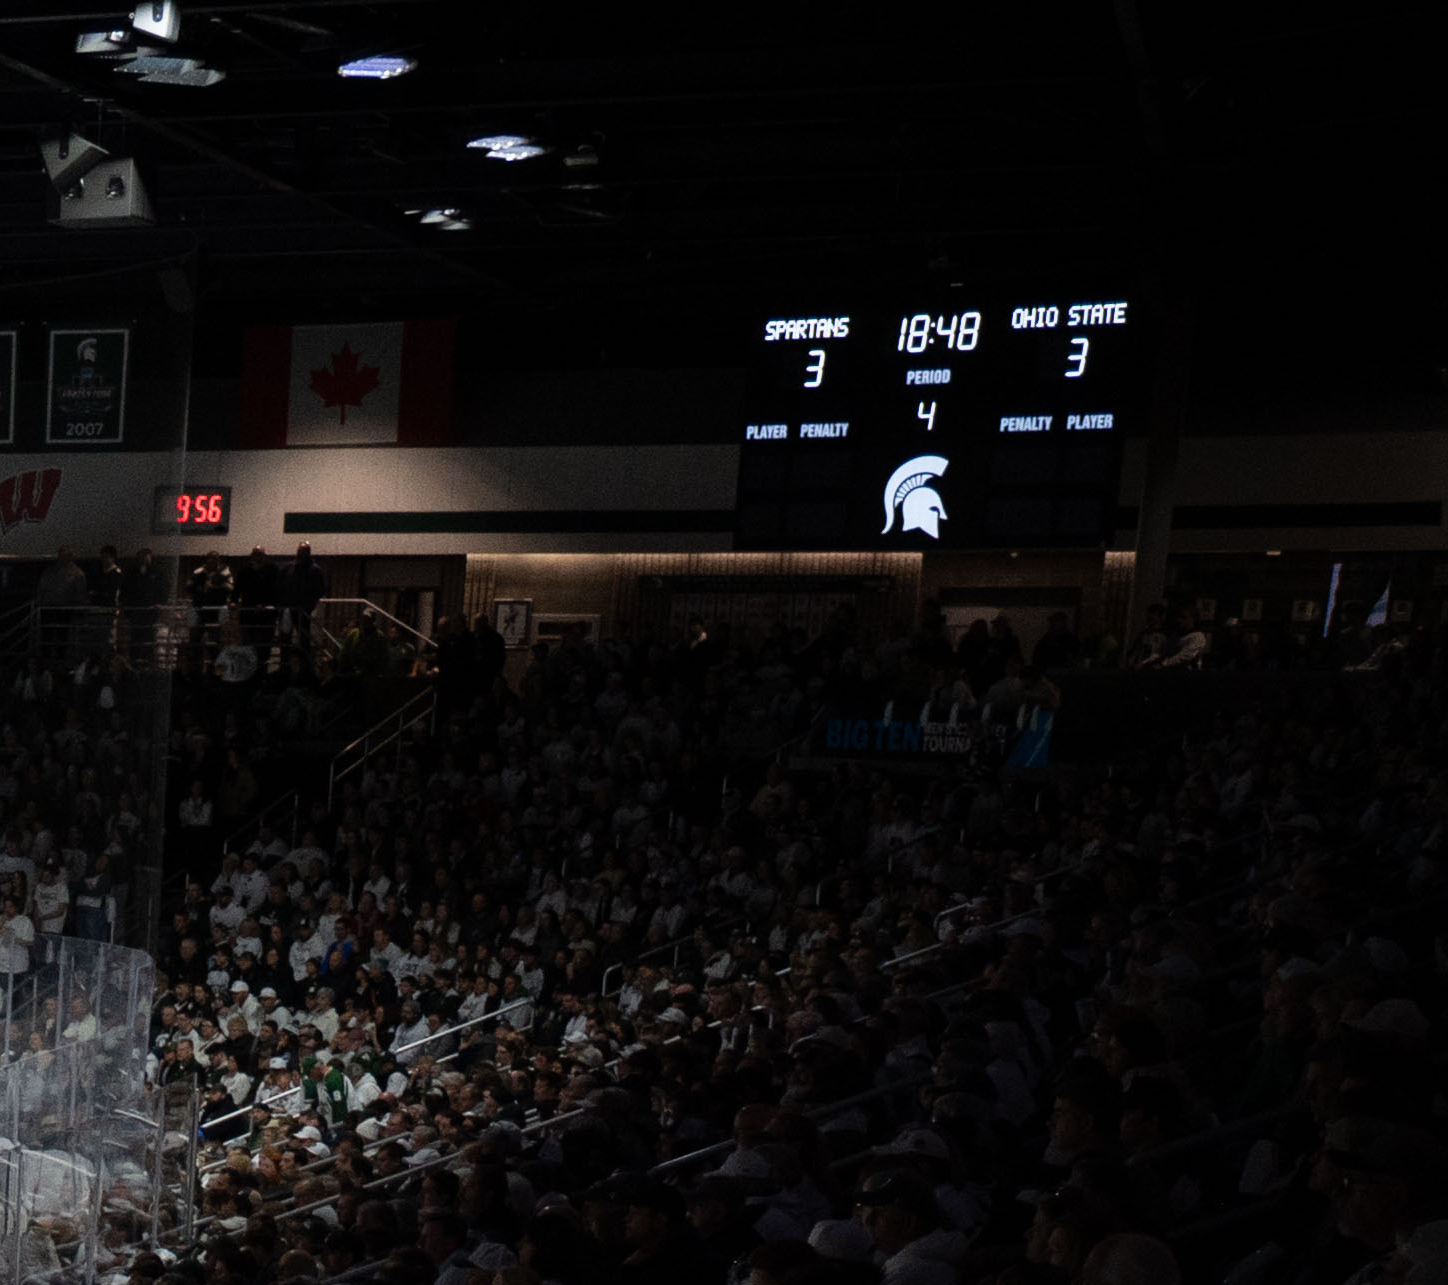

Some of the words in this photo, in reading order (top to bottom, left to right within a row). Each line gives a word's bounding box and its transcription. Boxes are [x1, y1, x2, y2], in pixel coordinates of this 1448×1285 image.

[1011, 306, 1059, 329] OHIO
[1068, 303, 1128, 327] STATE
[764, 317, 850, 341] SPARTANS
[897, 311, 981, 353] 18:48
[804, 350, 826, 388] 3
[1064, 338, 1089, 377] 3
[906, 369, 951, 385] PERIOD
[65, 422, 104, 436] 2007
[917, 402, 937, 431] 4
[999, 415, 1052, 433] PENALTY
[1066, 413, 1113, 431] PLAYER
[746, 424, 788, 440] PLAYER
[800, 422, 849, 438] PENALTY
